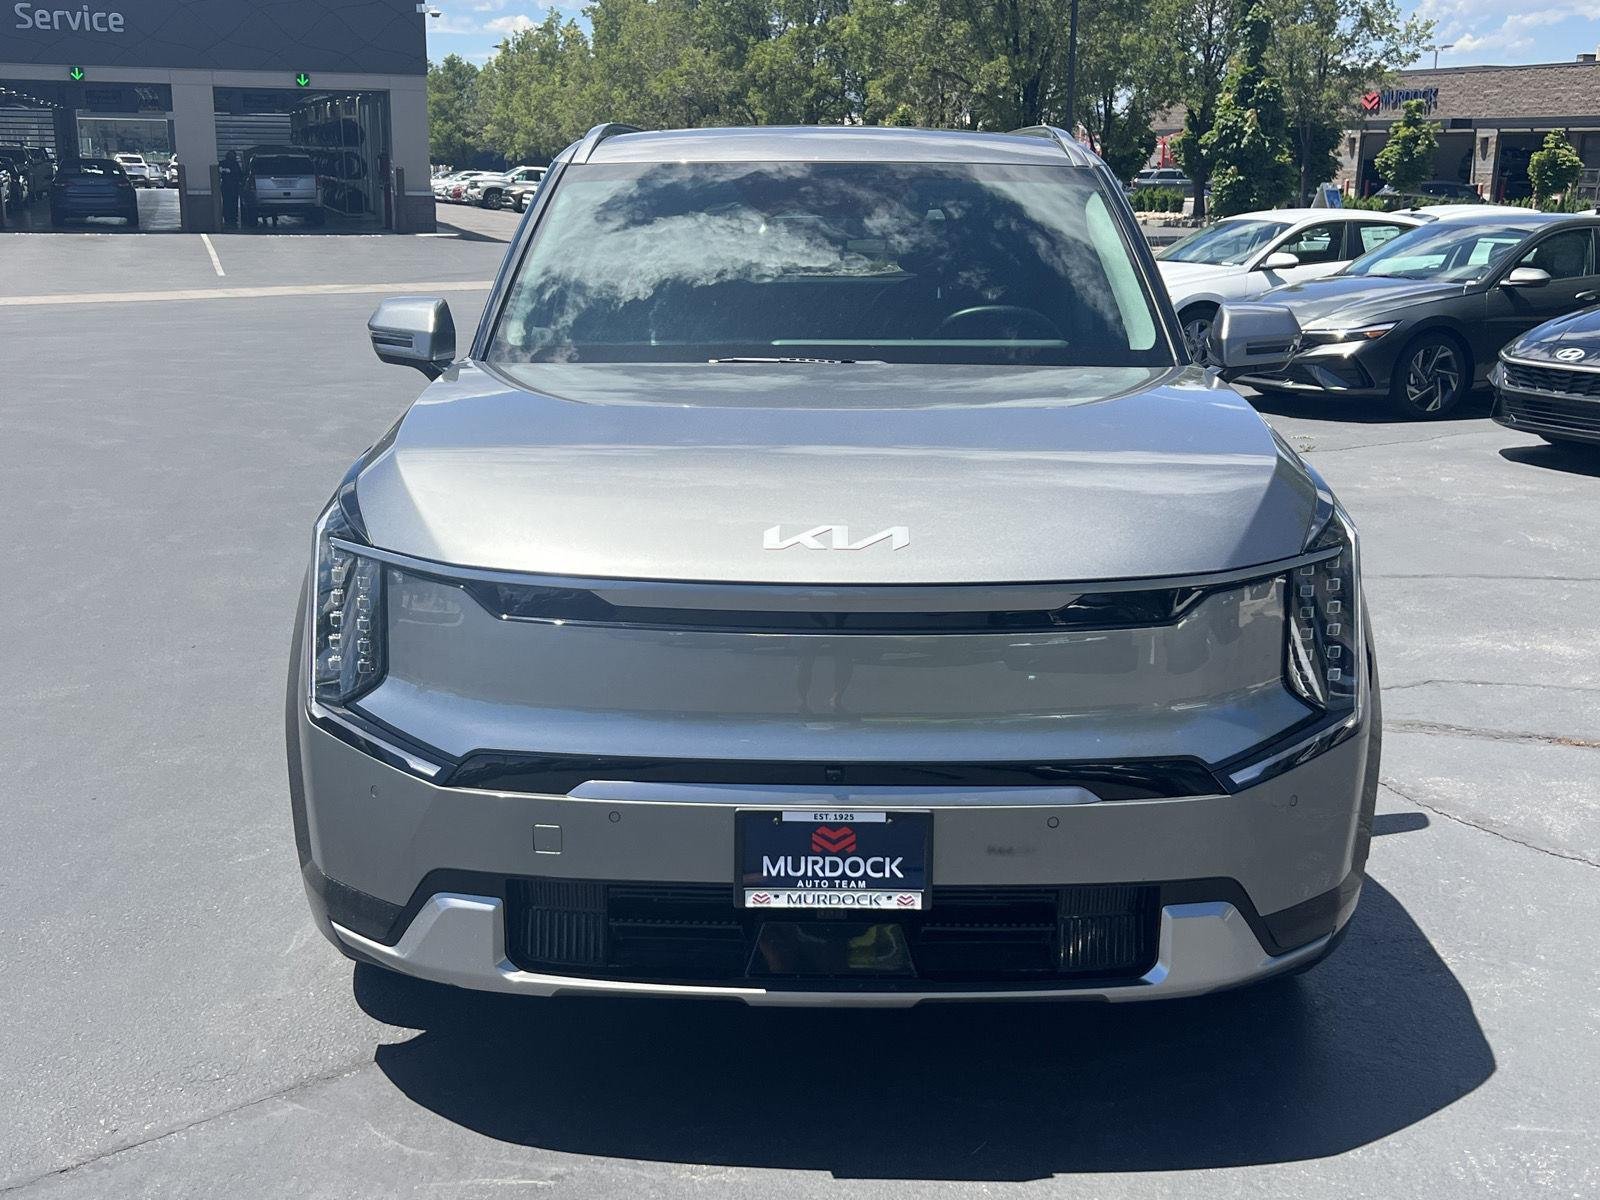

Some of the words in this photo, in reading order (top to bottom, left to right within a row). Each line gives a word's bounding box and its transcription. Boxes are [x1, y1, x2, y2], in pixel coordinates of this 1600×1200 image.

[14, 2, 125, 33] Service
[1380, 88, 1439, 103] MURDOCK
[763, 525, 910, 551] KIA
[813, 813, 832, 821] EST.
[833, 813, 855, 821] 1925
[762, 855, 904, 878] MURDOCK
[796, 879, 829, 888] AUTO
[834, 880, 867, 889] TEAM
[786, 892, 882, 906] MURDOCK
